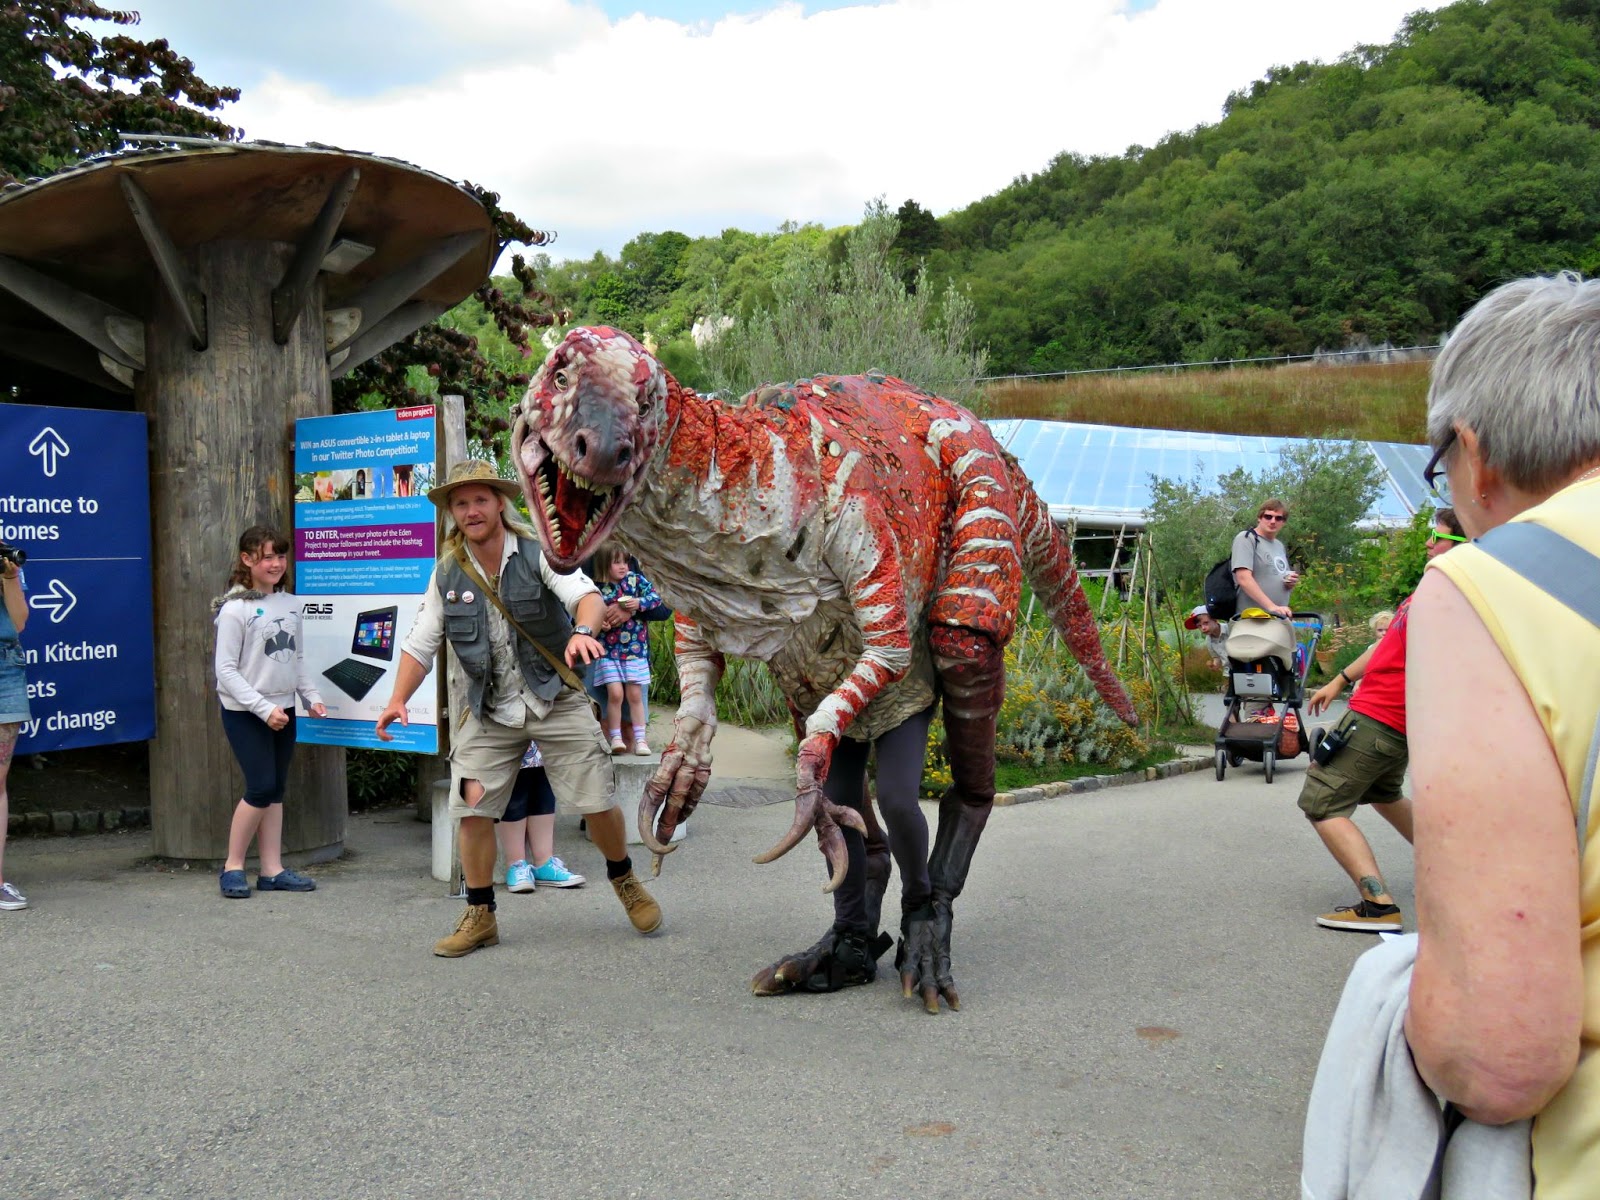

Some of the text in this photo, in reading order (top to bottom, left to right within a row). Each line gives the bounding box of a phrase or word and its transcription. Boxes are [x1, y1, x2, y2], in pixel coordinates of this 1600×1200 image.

[398, 407, 433, 418] eden project
[300, 441, 312, 450] WIN
[320, 438, 336, 448] ASUS
[337, 436, 369, 446] convertible
[370, 434, 384, 444] 2-in-1
[386, 432, 404, 442] tablet
[404, 432, 409, 440] &
[410, 430, 430, 442] laptop
[312, 452, 318, 462] in
[330, 451, 354, 460] Twitter
[355, 448, 374, 458] Photo
[376, 444, 418, 458] Competition!
[0, 495, 98, 514] ntrance to
[0, 519, 60, 540] iomes
[304, 531, 314, 540] TO
[316, 530, 340, 540] ENTER,
[366, 530, 382, 539] photo
[304, 542, 321, 550] Project
[340, 540, 362, 548] followers
[402, 537, 422, 547] hashtag
[304, 551, 347, 560] #edenphotocomp
[302, 603, 333, 614] ASUS
[45, 640, 118, 662] Kitchen
[26, 680, 56, 698] ets
[46, 710, 116, 731] change
